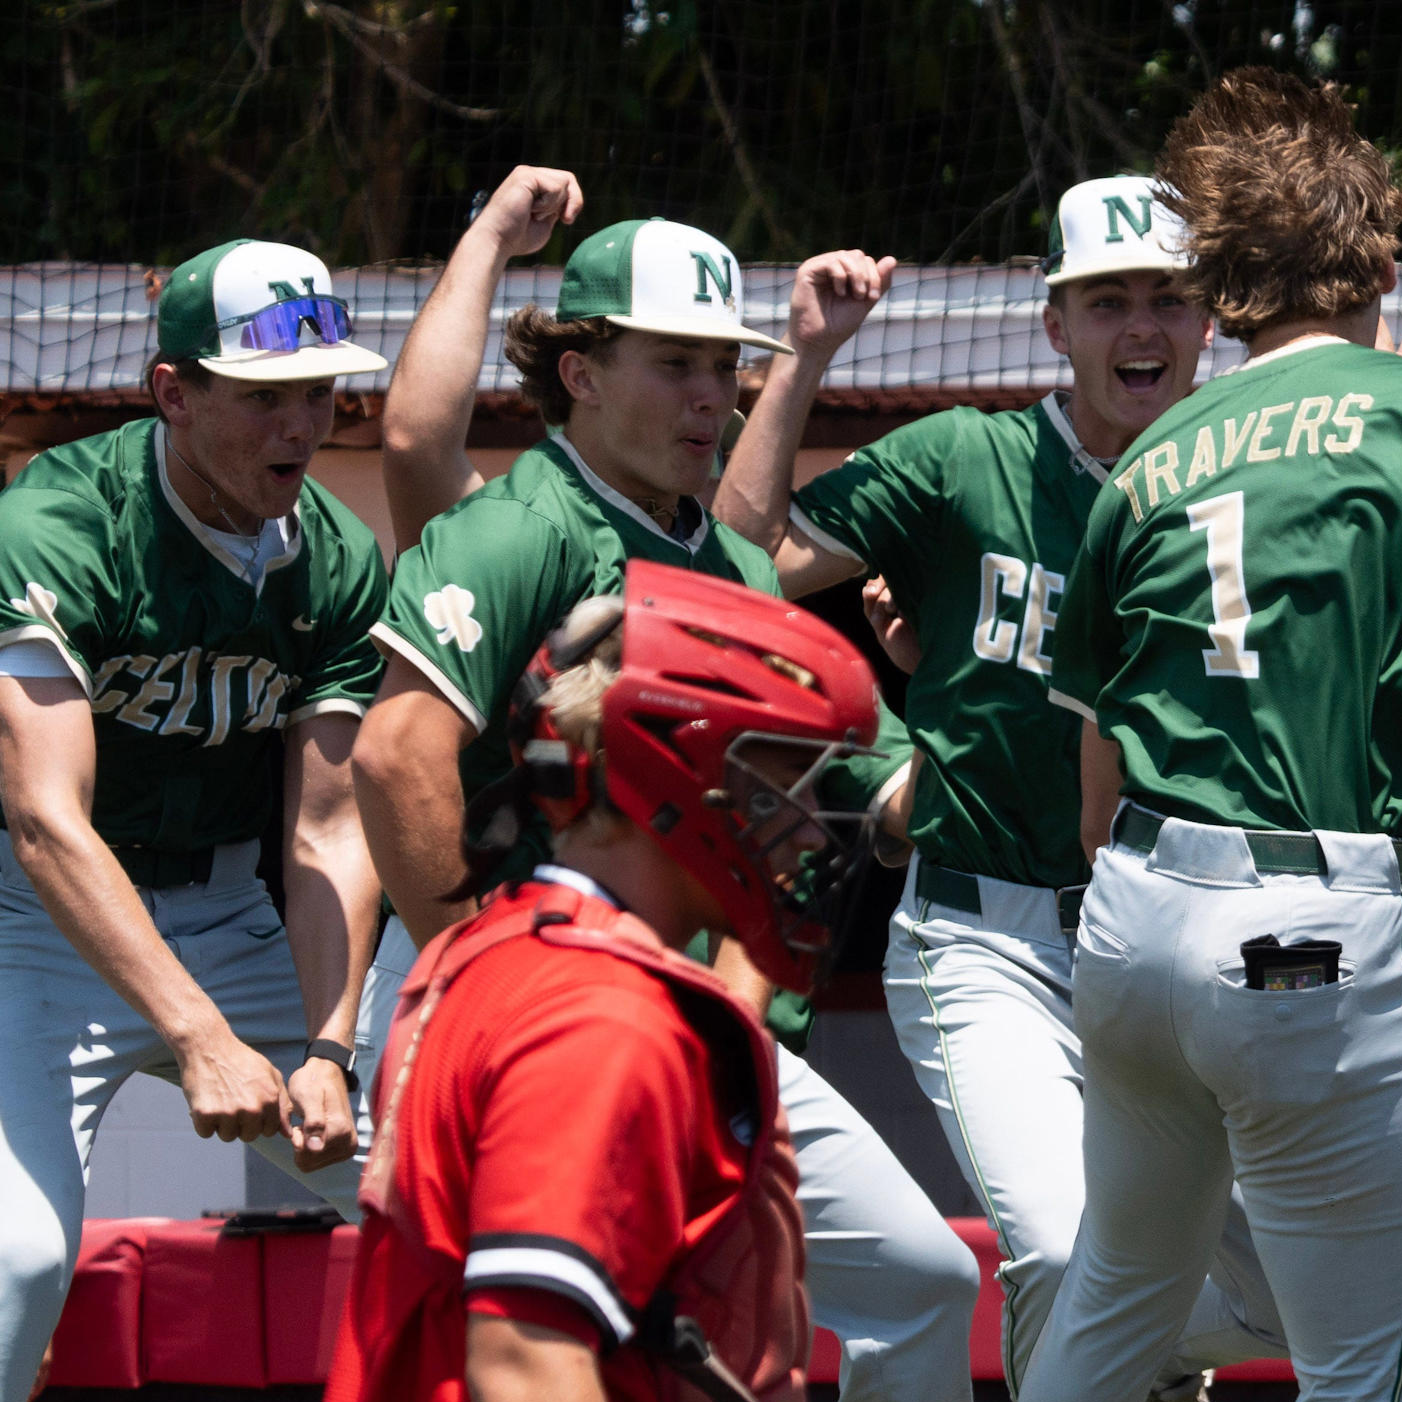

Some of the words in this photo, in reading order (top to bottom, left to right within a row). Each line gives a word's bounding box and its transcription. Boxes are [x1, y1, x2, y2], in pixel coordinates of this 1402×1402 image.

[1102, 195, 1154, 242] N
[689, 250, 733, 305] N
[1113, 392, 1374, 524] TRAVERS
[1186, 490, 1260, 679] 1
